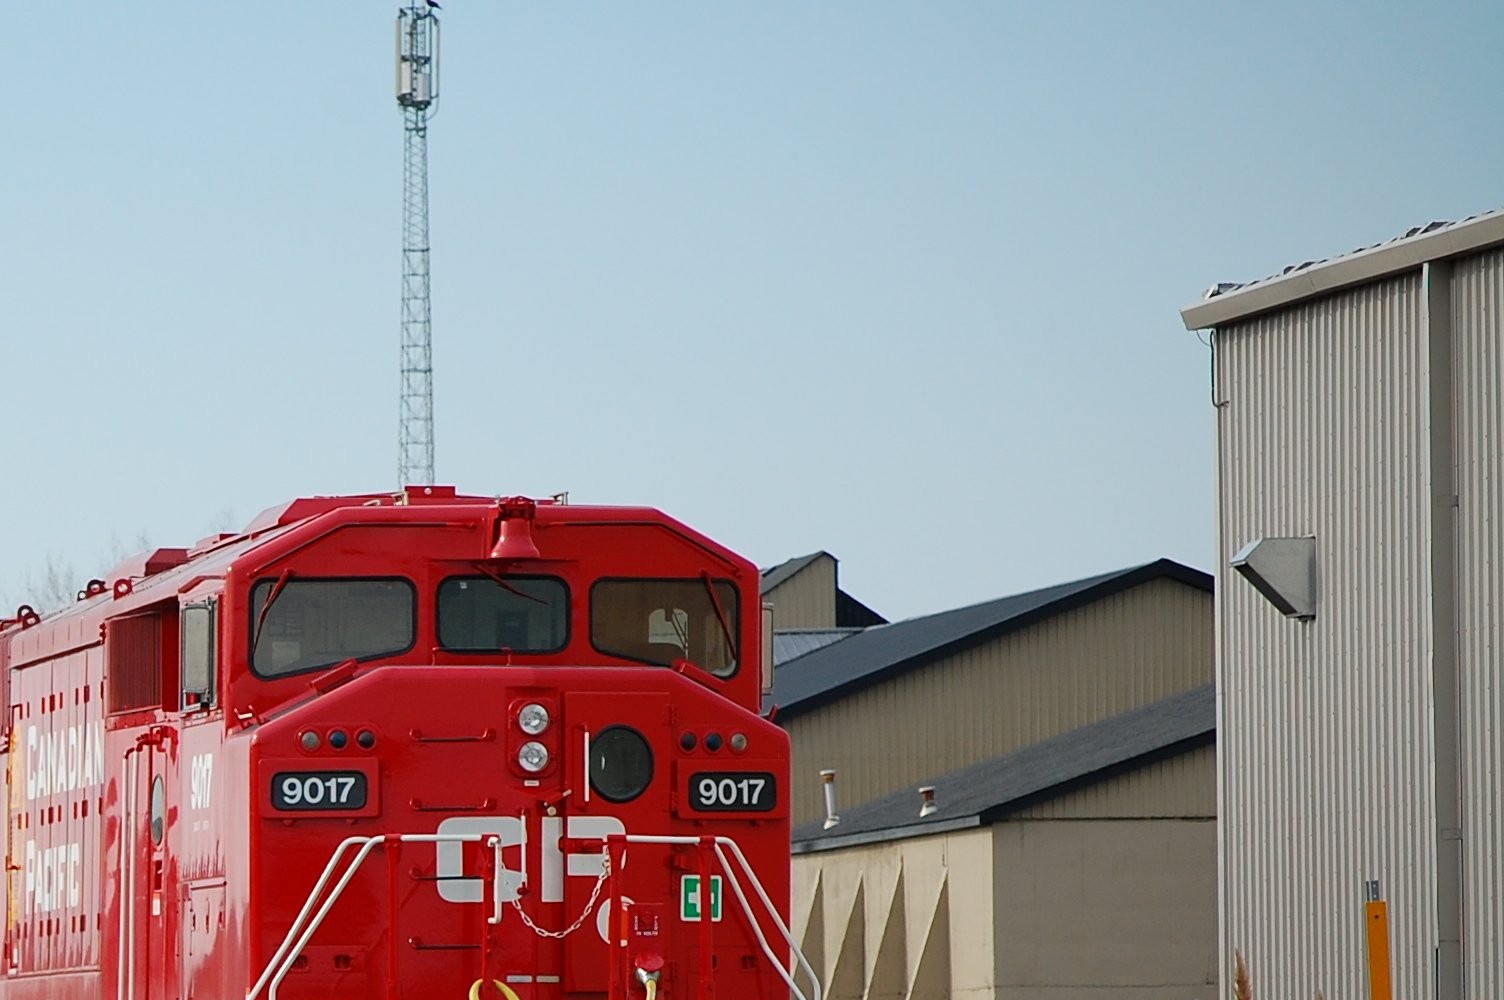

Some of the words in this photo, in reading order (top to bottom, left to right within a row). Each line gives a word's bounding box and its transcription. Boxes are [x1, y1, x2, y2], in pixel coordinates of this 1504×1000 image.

[27, 721, 105, 800] CANADIAN
[282, 777, 355, 804] 9017
[698, 778, 765, 805] 9017
[26, 839, 79, 915] PACIFIC
